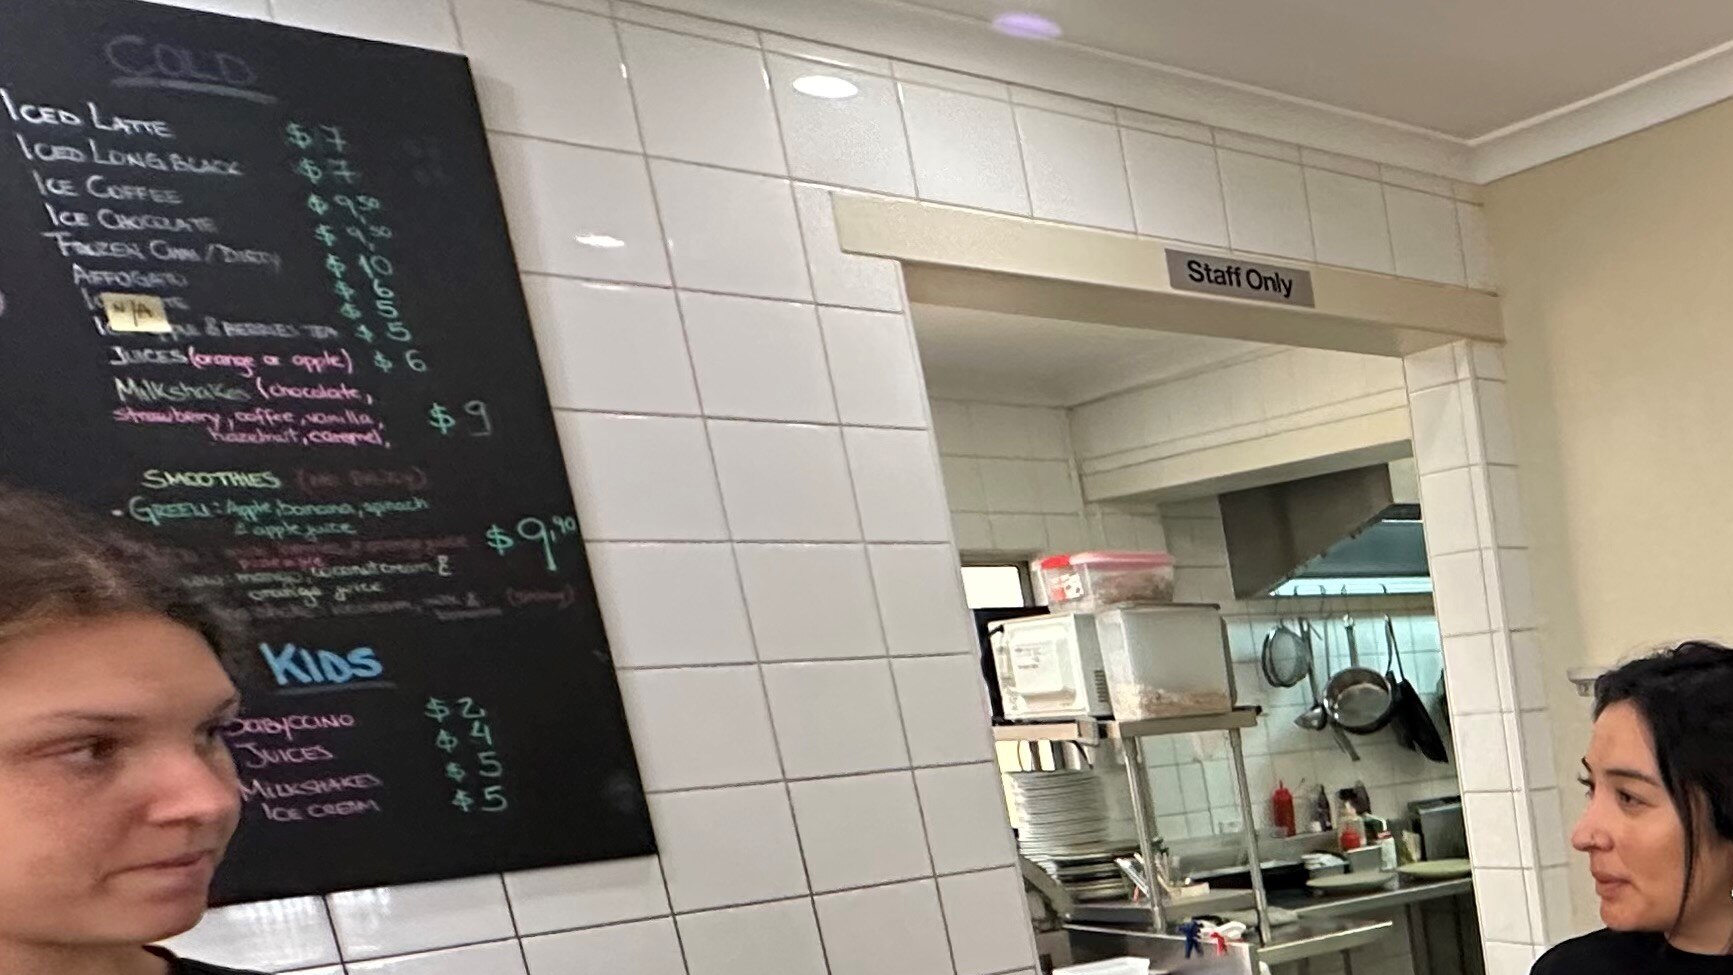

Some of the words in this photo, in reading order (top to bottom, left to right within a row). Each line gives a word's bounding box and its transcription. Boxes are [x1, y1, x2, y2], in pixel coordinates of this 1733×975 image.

[106, 34, 257, 84] COLD
[0, 87, 84, 125] ICED
[87, 102, 176, 138] LATTE
[16, 133, 86, 163] ICED
[88, 138, 169, 171] LONG
[32, 169, 80, 196] ICE
[85, 174, 184, 204] COFFEE
[44, 202, 91, 227] ICE
[1186, 259, 1242, 288] Staff
[1246, 268, 1293, 299] Only
[142, 469, 283, 490] SMOOTHIES
[258, 642, 384, 686] KIDS
[235, 743, 334, 769] JUICES
